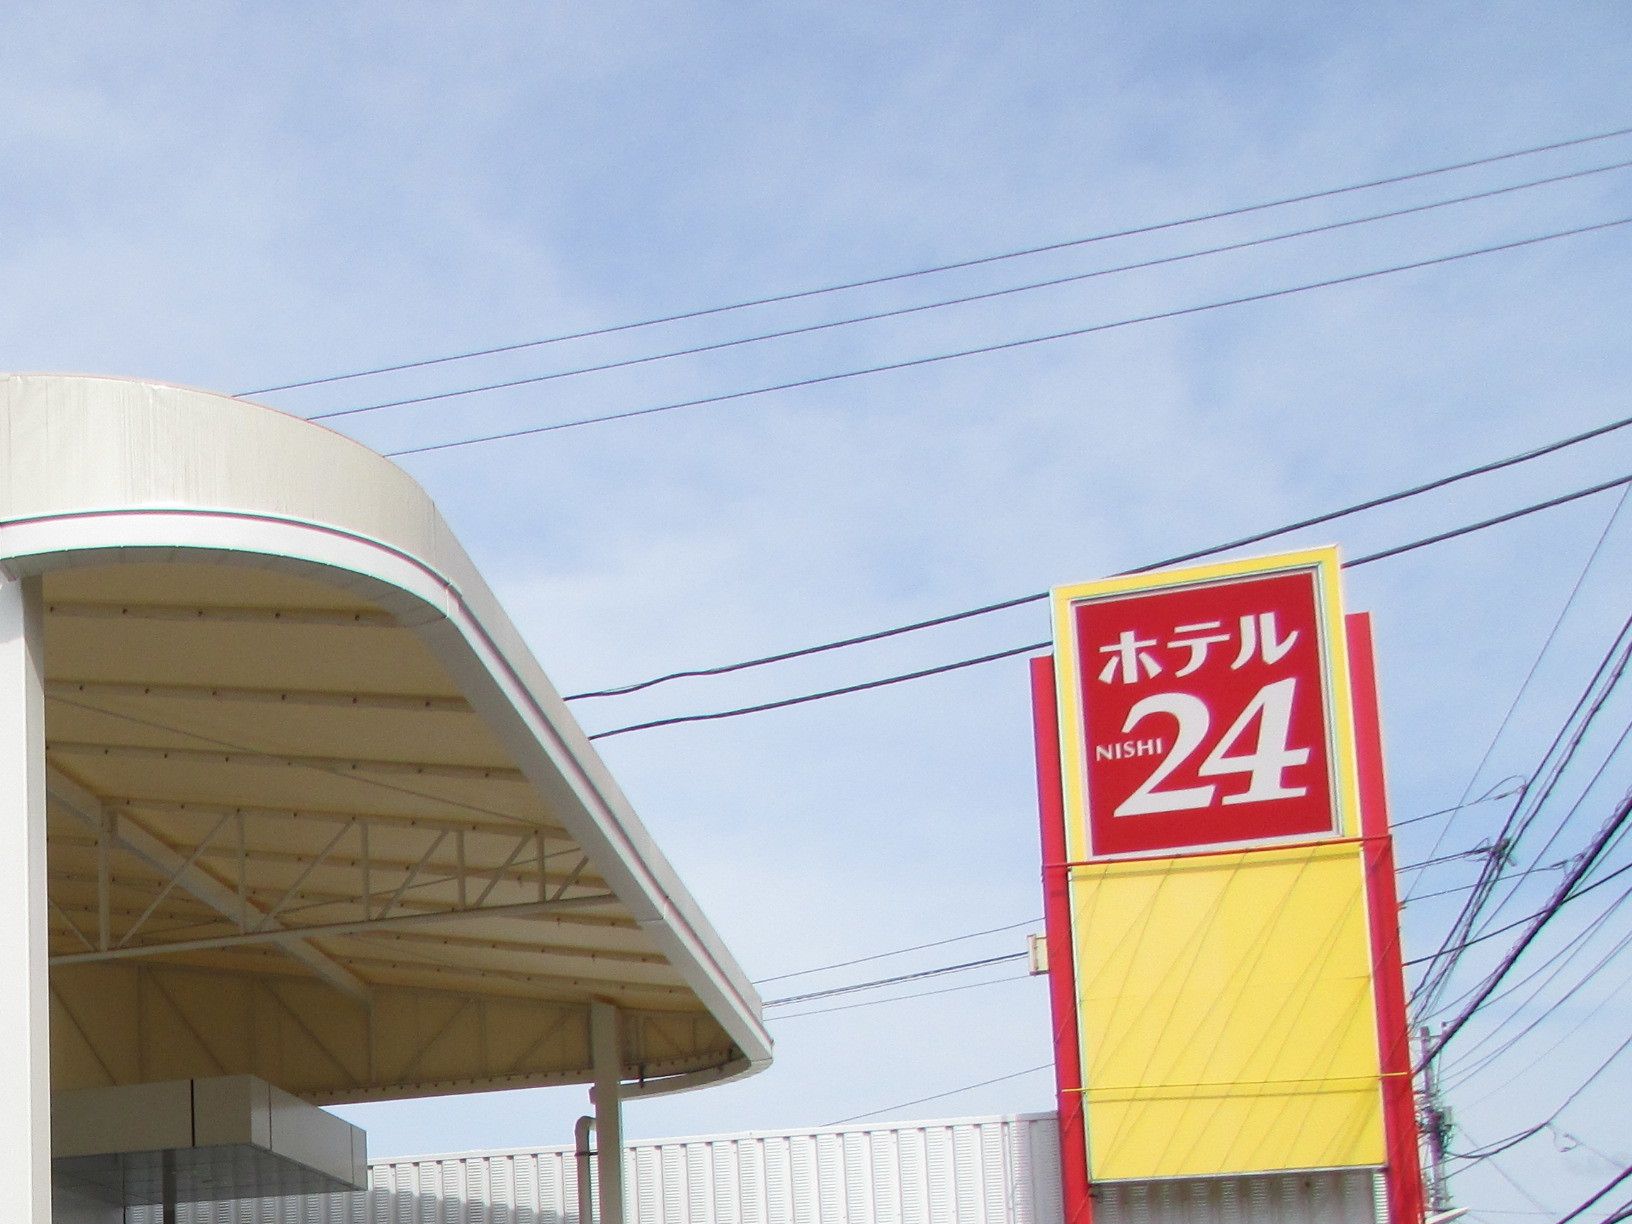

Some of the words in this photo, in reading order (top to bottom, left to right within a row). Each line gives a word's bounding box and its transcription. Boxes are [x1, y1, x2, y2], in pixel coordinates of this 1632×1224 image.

[1097, 611, 1300, 685] ホテル
[1095, 737, 1164, 762] NISHI
[1112, 677, 1311, 818] 24
